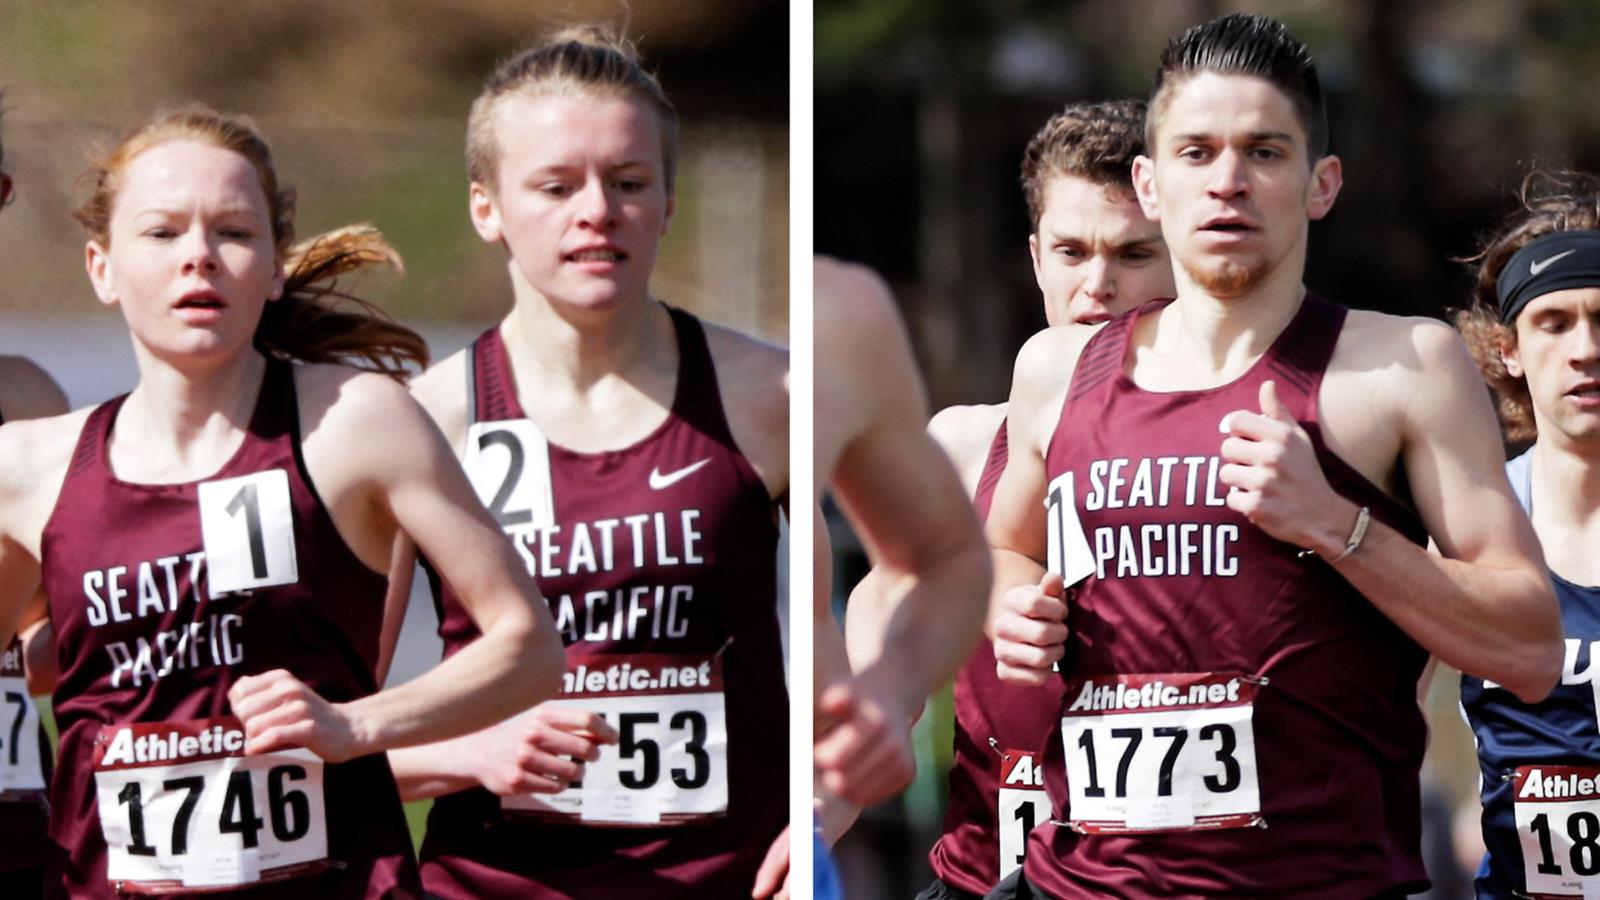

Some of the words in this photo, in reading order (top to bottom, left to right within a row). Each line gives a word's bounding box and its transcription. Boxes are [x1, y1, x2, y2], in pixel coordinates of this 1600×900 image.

[478, 429, 533, 526] 2
[1086, 456, 1226, 511] SEATTL
[224, 483, 269, 579] 1
[510, 510, 703, 577] SEATTLE
[1095, 524, 1239, 579] PACIFIC
[83, 551, 253, 627] SEATT
[545, 585, 693, 641] ACIFIC
[105, 614, 243, 688] PACIFIC
[562, 663, 710, 693] letic.net
[5, 691, 27, 765] 7
[1068, 679, 1240, 712] Athletic.net
[101, 726, 248, 765] Athletic
[597, 711, 710, 789] 53
[1005, 756, 1043, 786] At
[1078, 723, 1241, 798] 1773
[118, 764, 310, 857] 1746
[1519, 769, 1600, 798] Athlet
[1014, 800, 1036, 865] 1
[1530, 811, 1600, 876] 18
